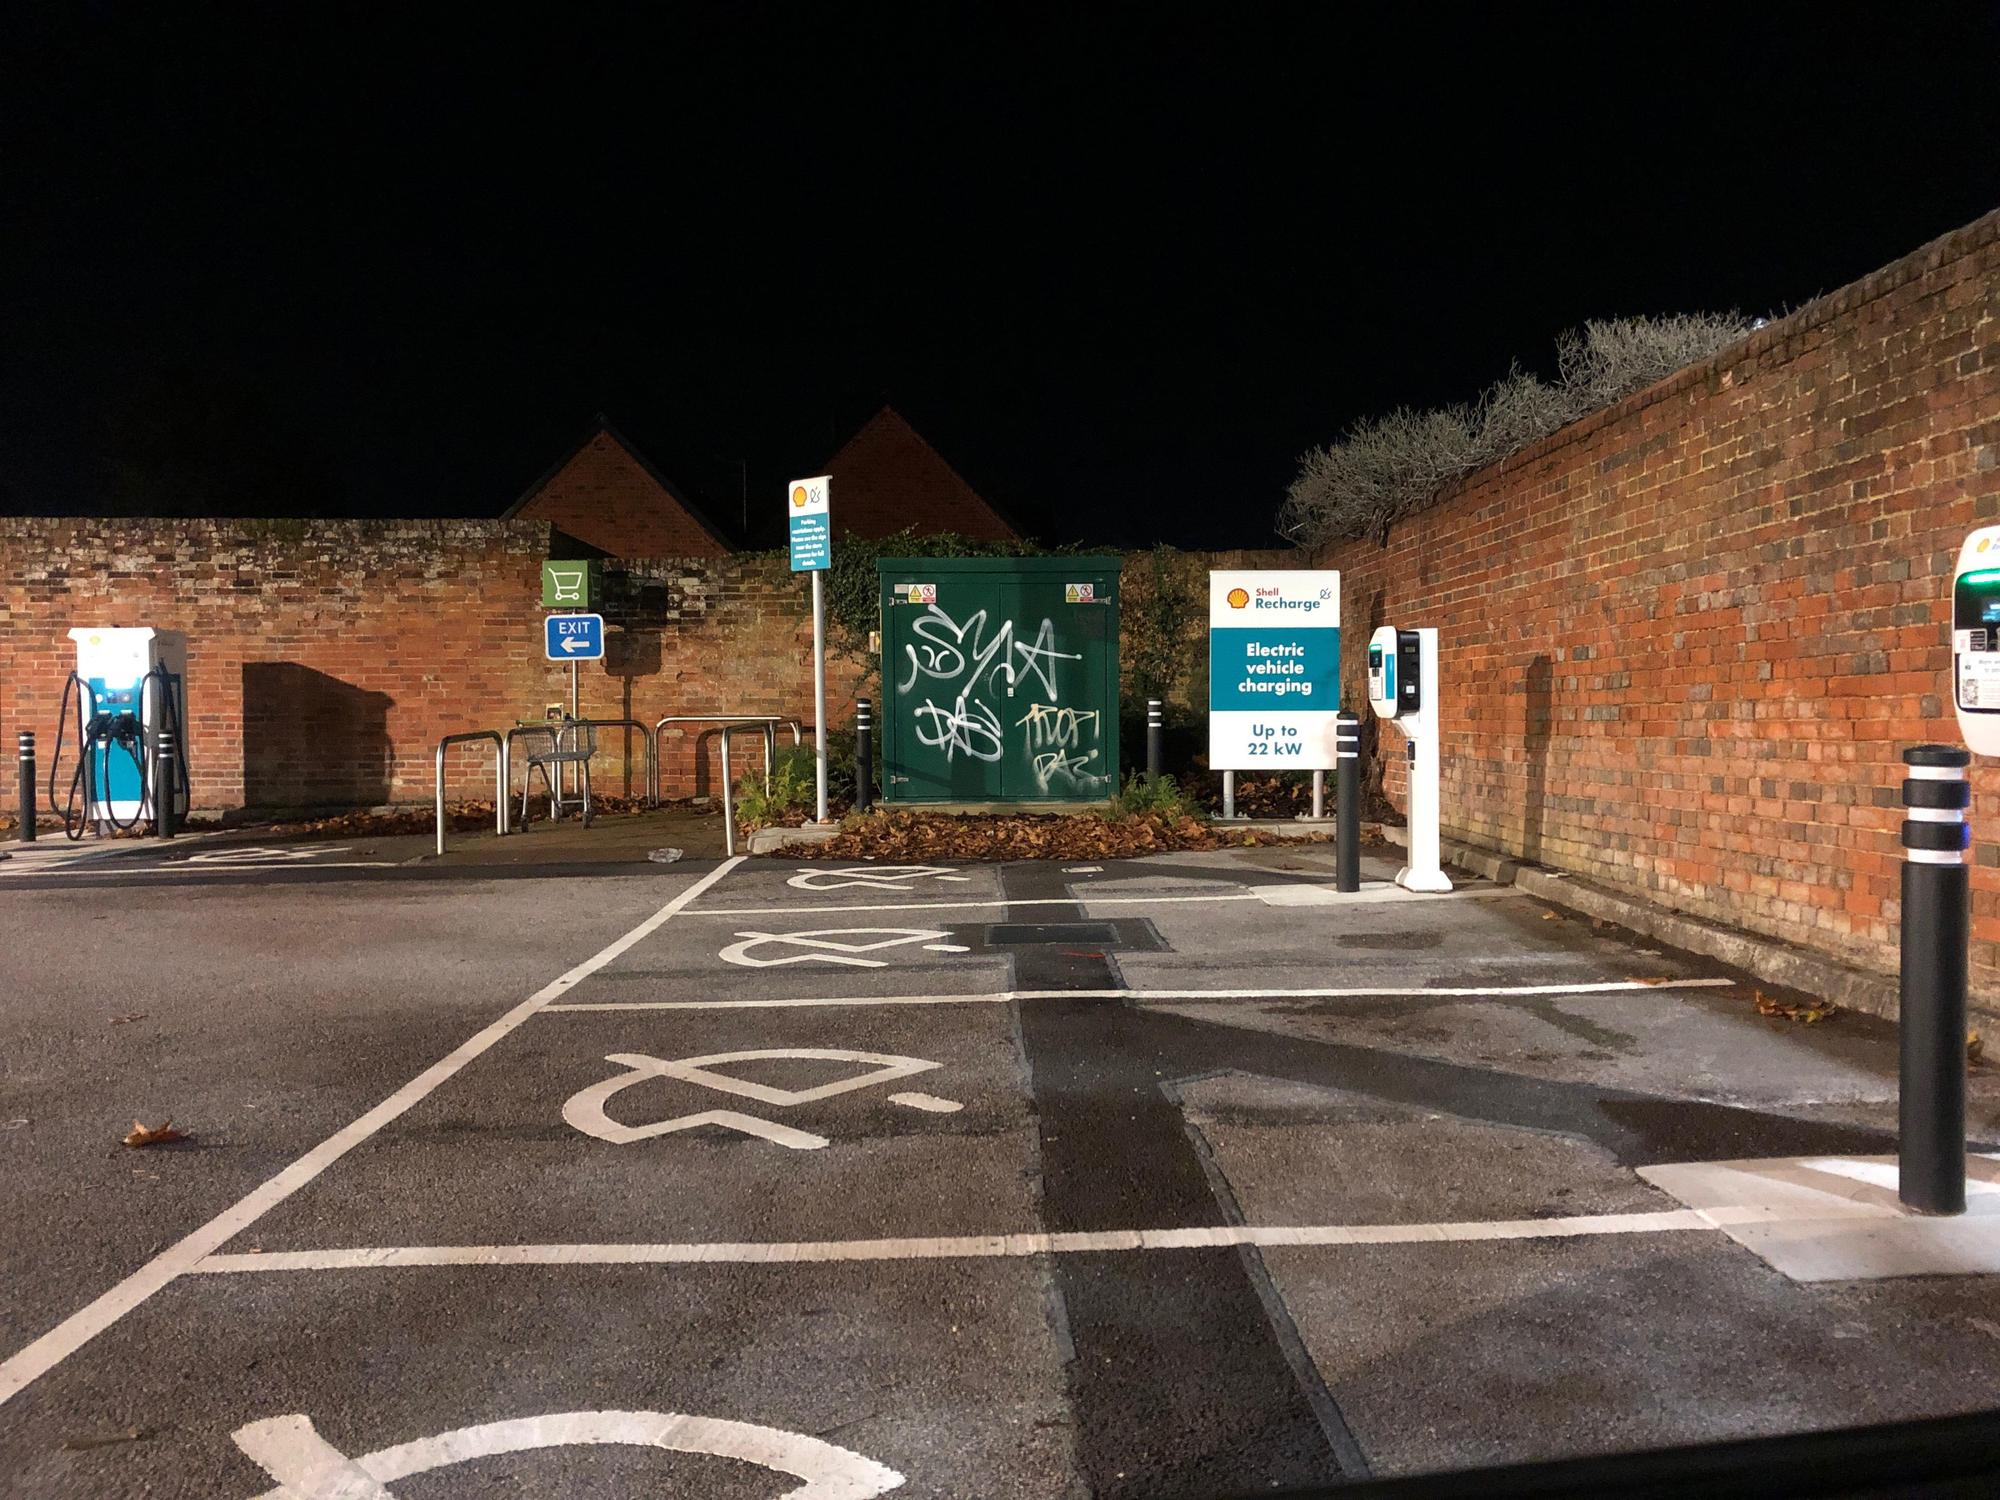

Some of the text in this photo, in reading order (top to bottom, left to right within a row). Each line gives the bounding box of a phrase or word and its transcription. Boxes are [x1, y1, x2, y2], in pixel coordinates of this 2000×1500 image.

[1256, 588, 1279, 597] Shell
[1255, 597, 1321, 612] Recharge
[559, 621, 590, 634] EXIT
[1246, 642, 1305, 657] Electric
[1246, 660, 1305, 675] vehicle
[1238, 678, 1313, 696] charging
[1252, 724, 1298, 740] Up to
[1248, 742, 1303, 755] 22 kW
